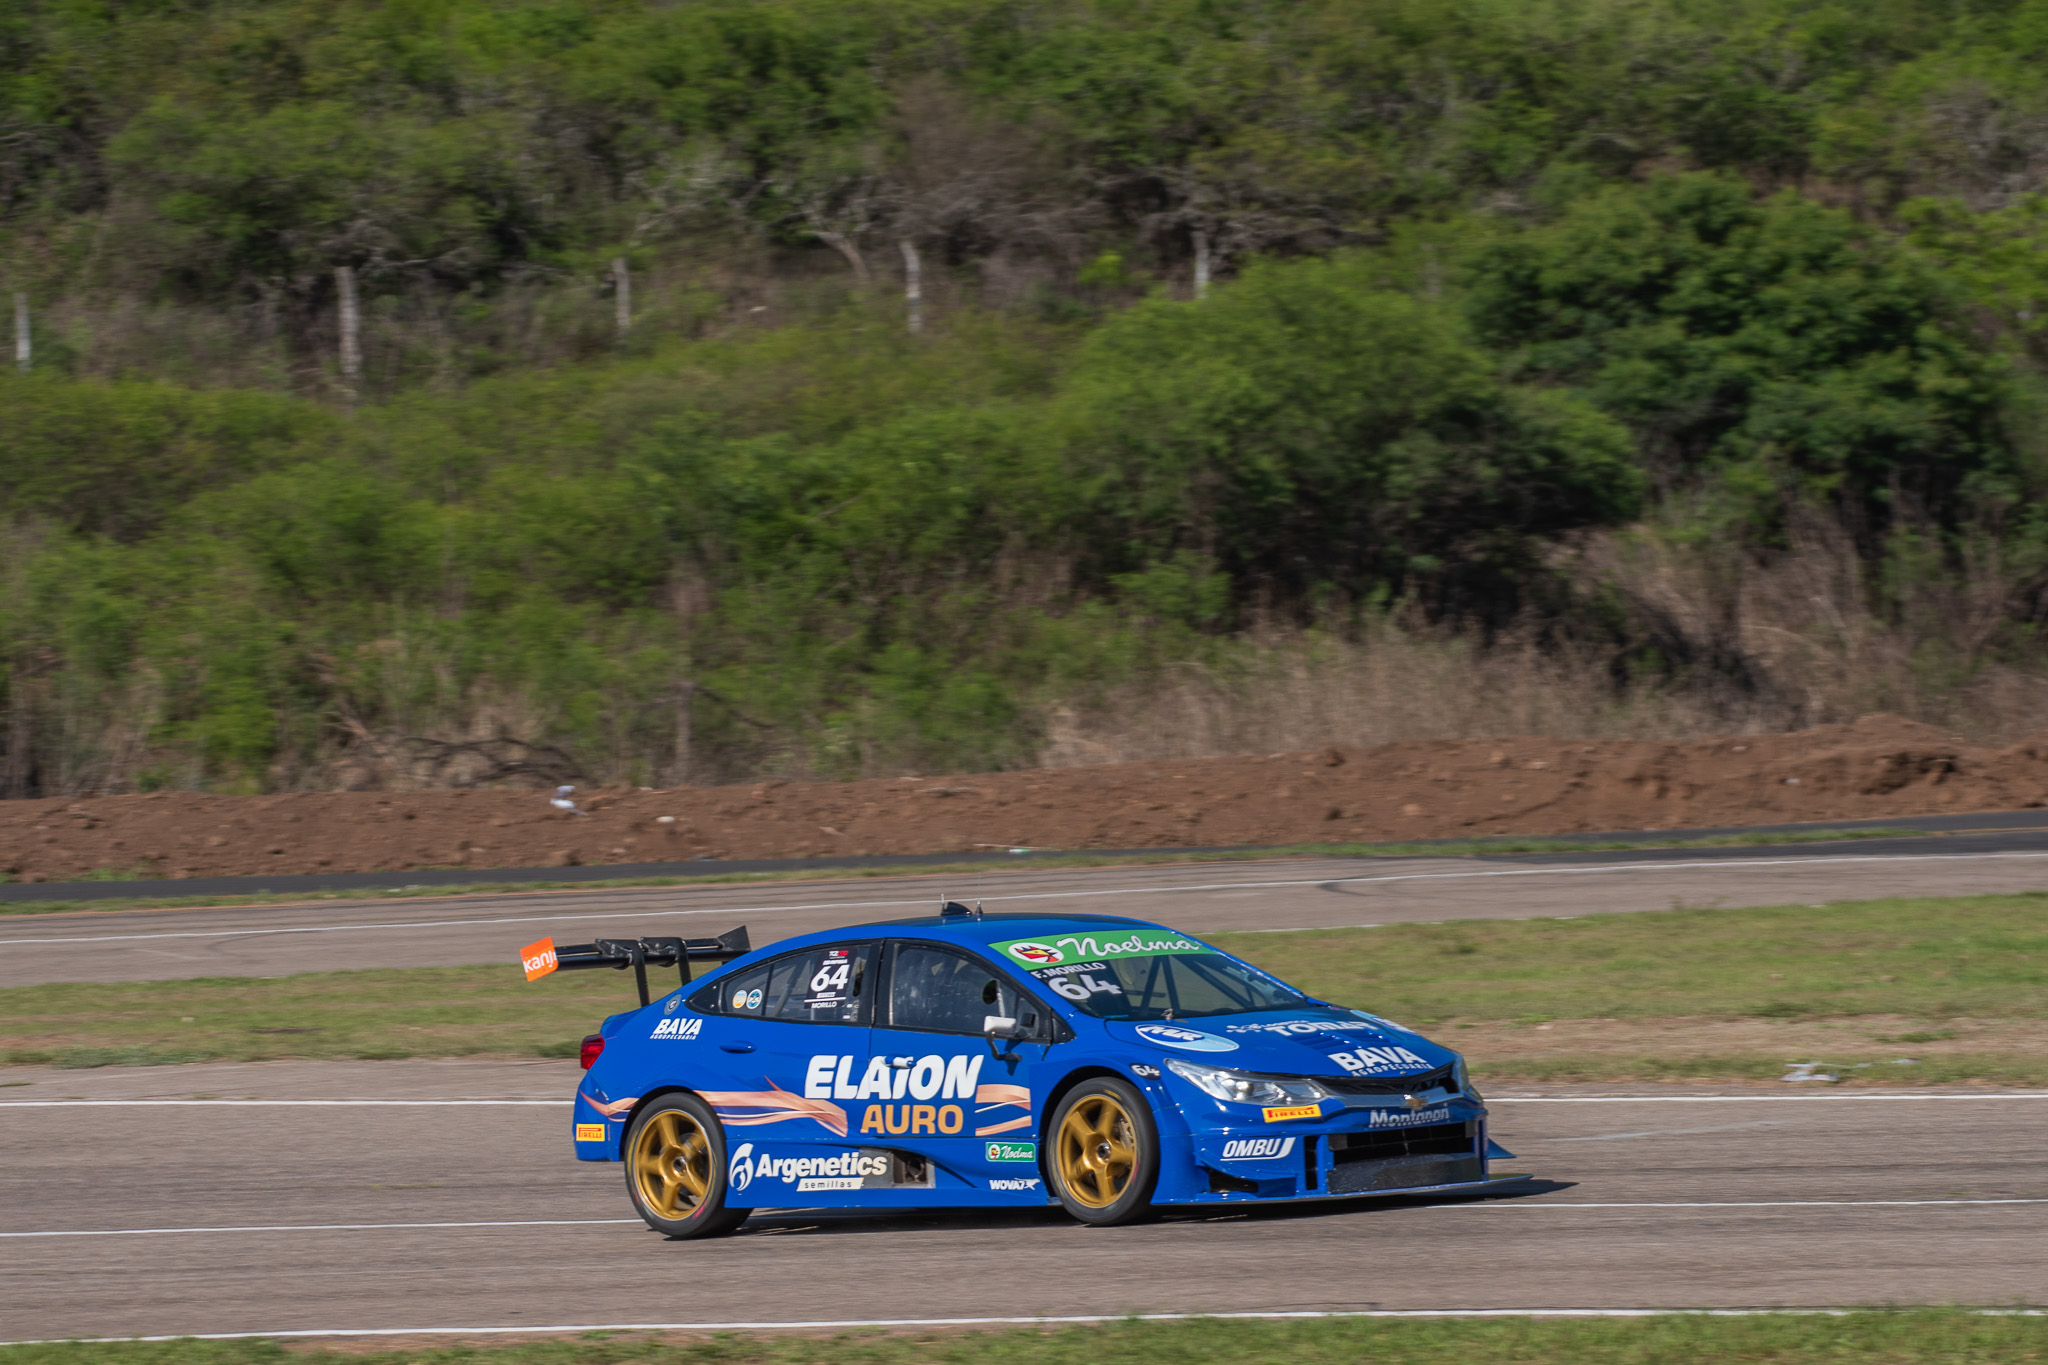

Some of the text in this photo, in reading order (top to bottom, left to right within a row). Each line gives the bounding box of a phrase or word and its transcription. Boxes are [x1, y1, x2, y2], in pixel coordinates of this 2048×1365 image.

[1056, 935, 1200, 957] Noelma
[810, 964, 850, 992] 64
[1049, 962, 1107, 978] MORILLO
[1048, 974, 1123, 1001] 64
[653, 1018, 703, 1035] BAVA
[1328, 1046, 1427, 1072] BAVA
[1131, 1064, 1160, 1077] 64
[860, 1104, 964, 1135] AURO
[1268, 1107, 1316, 1119] PIRELLI
[579, 1128, 602, 1139] PIRELLI
[1000, 1145, 1034, 1160] Noelma
[1222, 1138, 1280, 1158] OMBU
[755, 1152, 888, 1184] Argenetics
[804, 1180, 852, 1189] semillas
